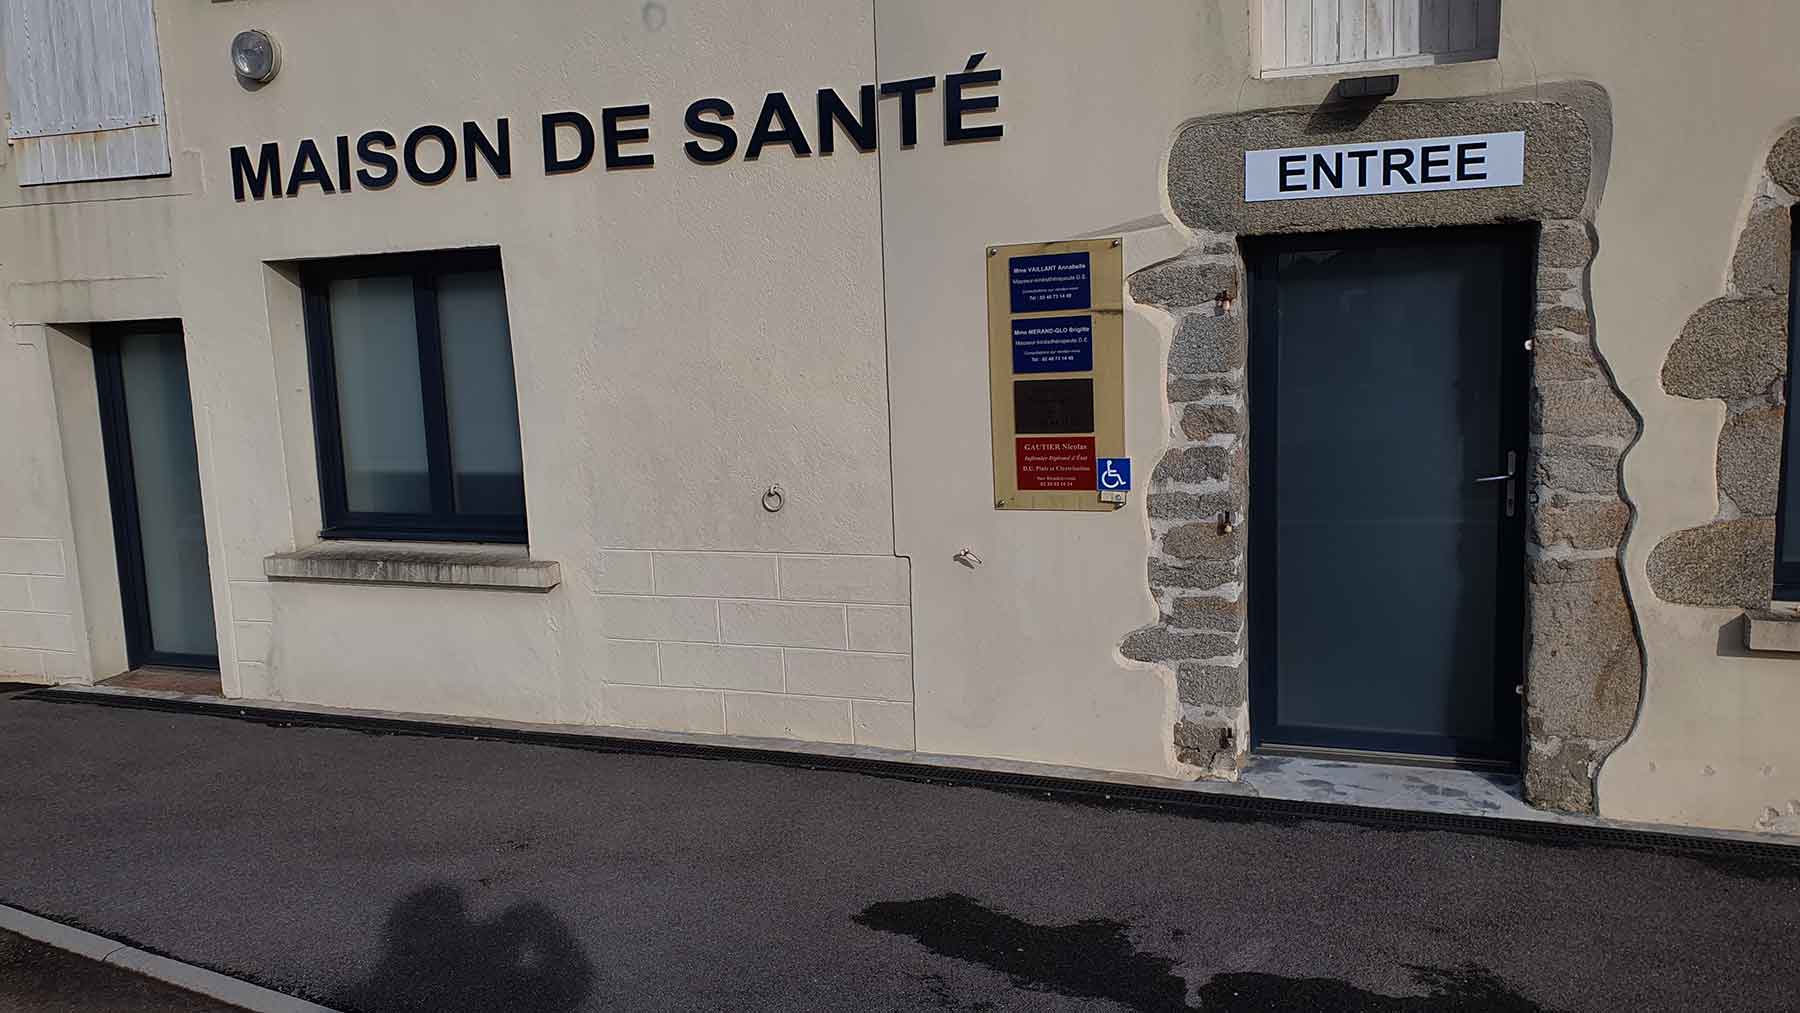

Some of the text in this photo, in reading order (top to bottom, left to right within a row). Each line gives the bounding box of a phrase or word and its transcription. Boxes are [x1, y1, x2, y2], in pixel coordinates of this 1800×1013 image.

[230, 53, 1003, 202] MAISON DE SANTÉ
[1279, 143, 1487, 192] ENTREE
